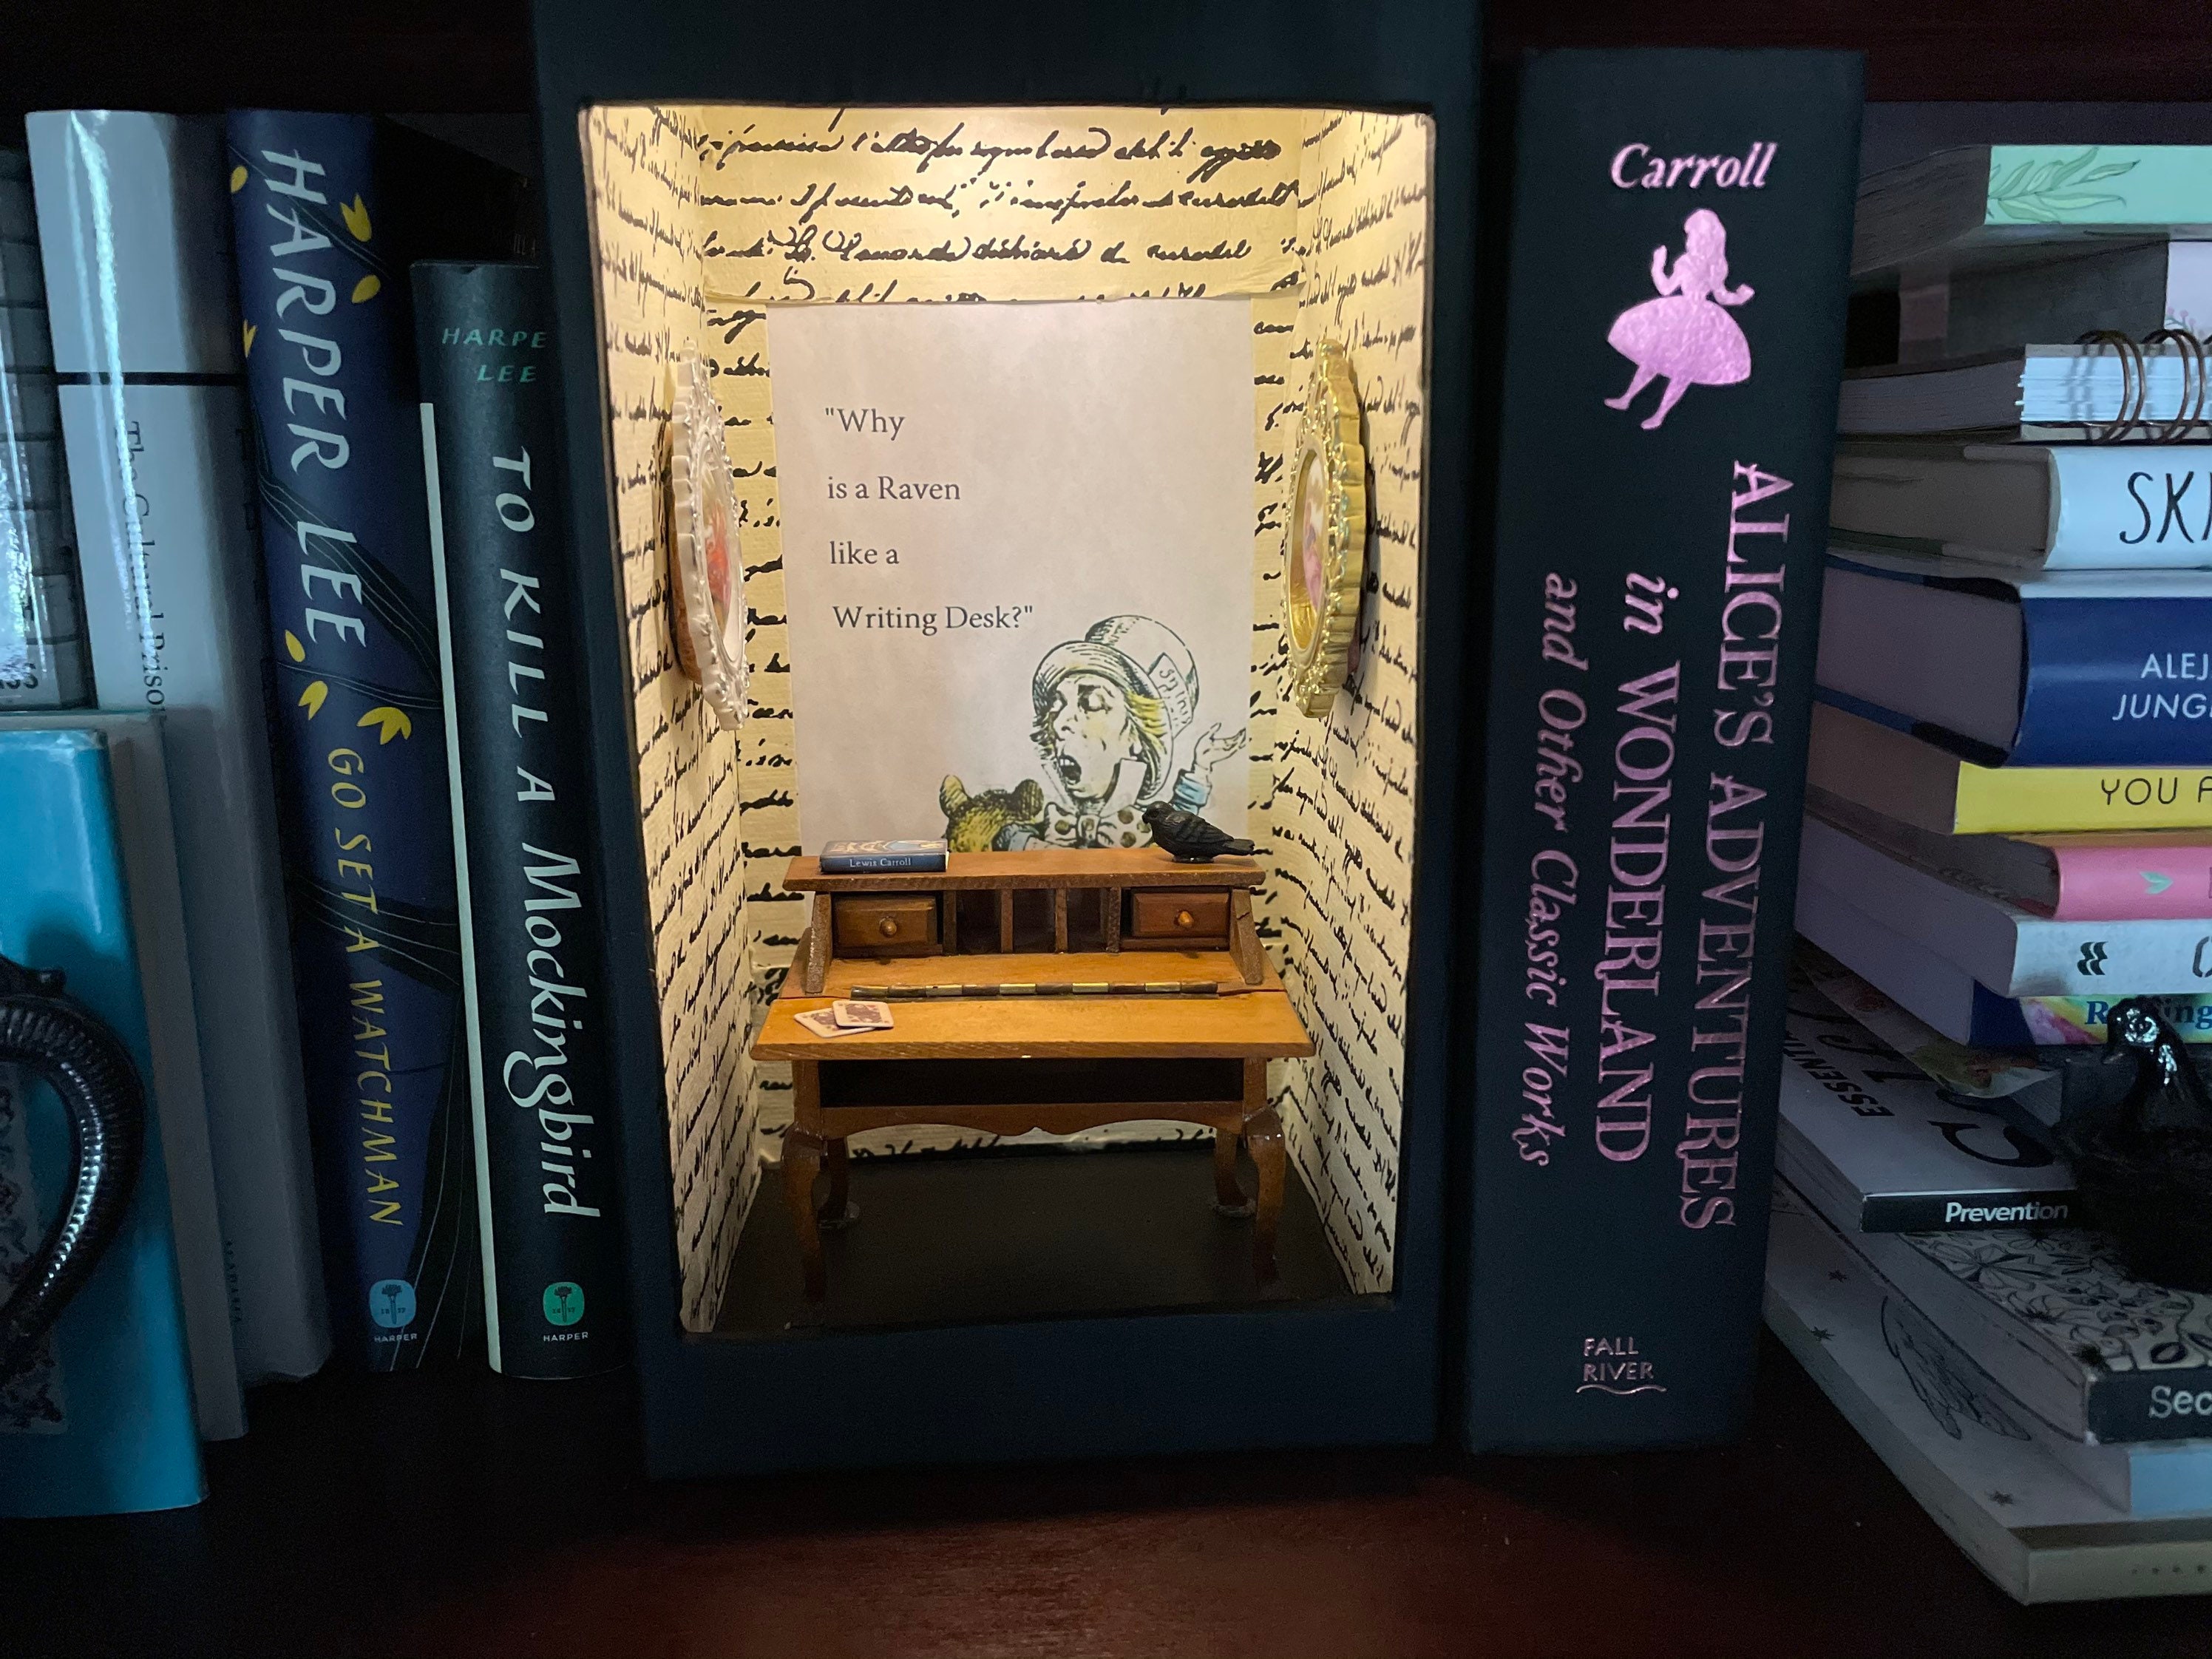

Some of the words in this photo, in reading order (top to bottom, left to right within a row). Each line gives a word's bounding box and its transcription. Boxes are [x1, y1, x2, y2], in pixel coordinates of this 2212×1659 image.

[1609, 142, 1777, 188] Carroll
[262, 149, 350, 472] HARPER
[475, 364, 537, 383] LEE
[824, 407, 906, 441] "Why
[492, 445, 535, 533] TO
[827, 475, 848, 499] is
[855, 482, 870, 500] a
[877, 475, 961, 500] Raven
[829, 540, 878, 565] like
[885, 548, 900, 565] a
[297, 519, 366, 648] LEE
[1624, 572, 1679, 635] in
[1714, 459, 1794, 747] ALICE'S
[832, 605, 938, 637] Writing
[945, 605, 1034, 629] Desk?"
[1543, 572, 1589, 671] and
[499, 567, 549, 739] KILL
[2111, 693, 2212, 721] JUNG
[327, 747, 367, 807] GO
[515, 764, 554, 803] A
[1535, 689, 1587, 832] Other
[2101, 776, 2178, 806] YOU
[335, 827, 378, 914] SET
[849, 858, 878, 868] Lewis
[880, 857, 912, 867] Carroll
[1525, 849, 1578, 1008] Classic
[1594, 659, 1680, 1162] WONDERLAND
[343, 923, 380, 954] A
[1675, 770, 1768, 1229] ADVENTURES
[503, 841, 601, 1218] Mockingbird
[347, 979, 404, 1227] WATCHMAN
[1512, 1022, 1571, 1167] Works
[1945, 1201, 2069, 1224] Prevention
[373, 1333, 418, 1343] HARPER
[543, 1331, 589, 1342] HARPER
[1583, 1336, 1640, 1357] FALL
[1582, 1361, 1654, 1381] RIVER
